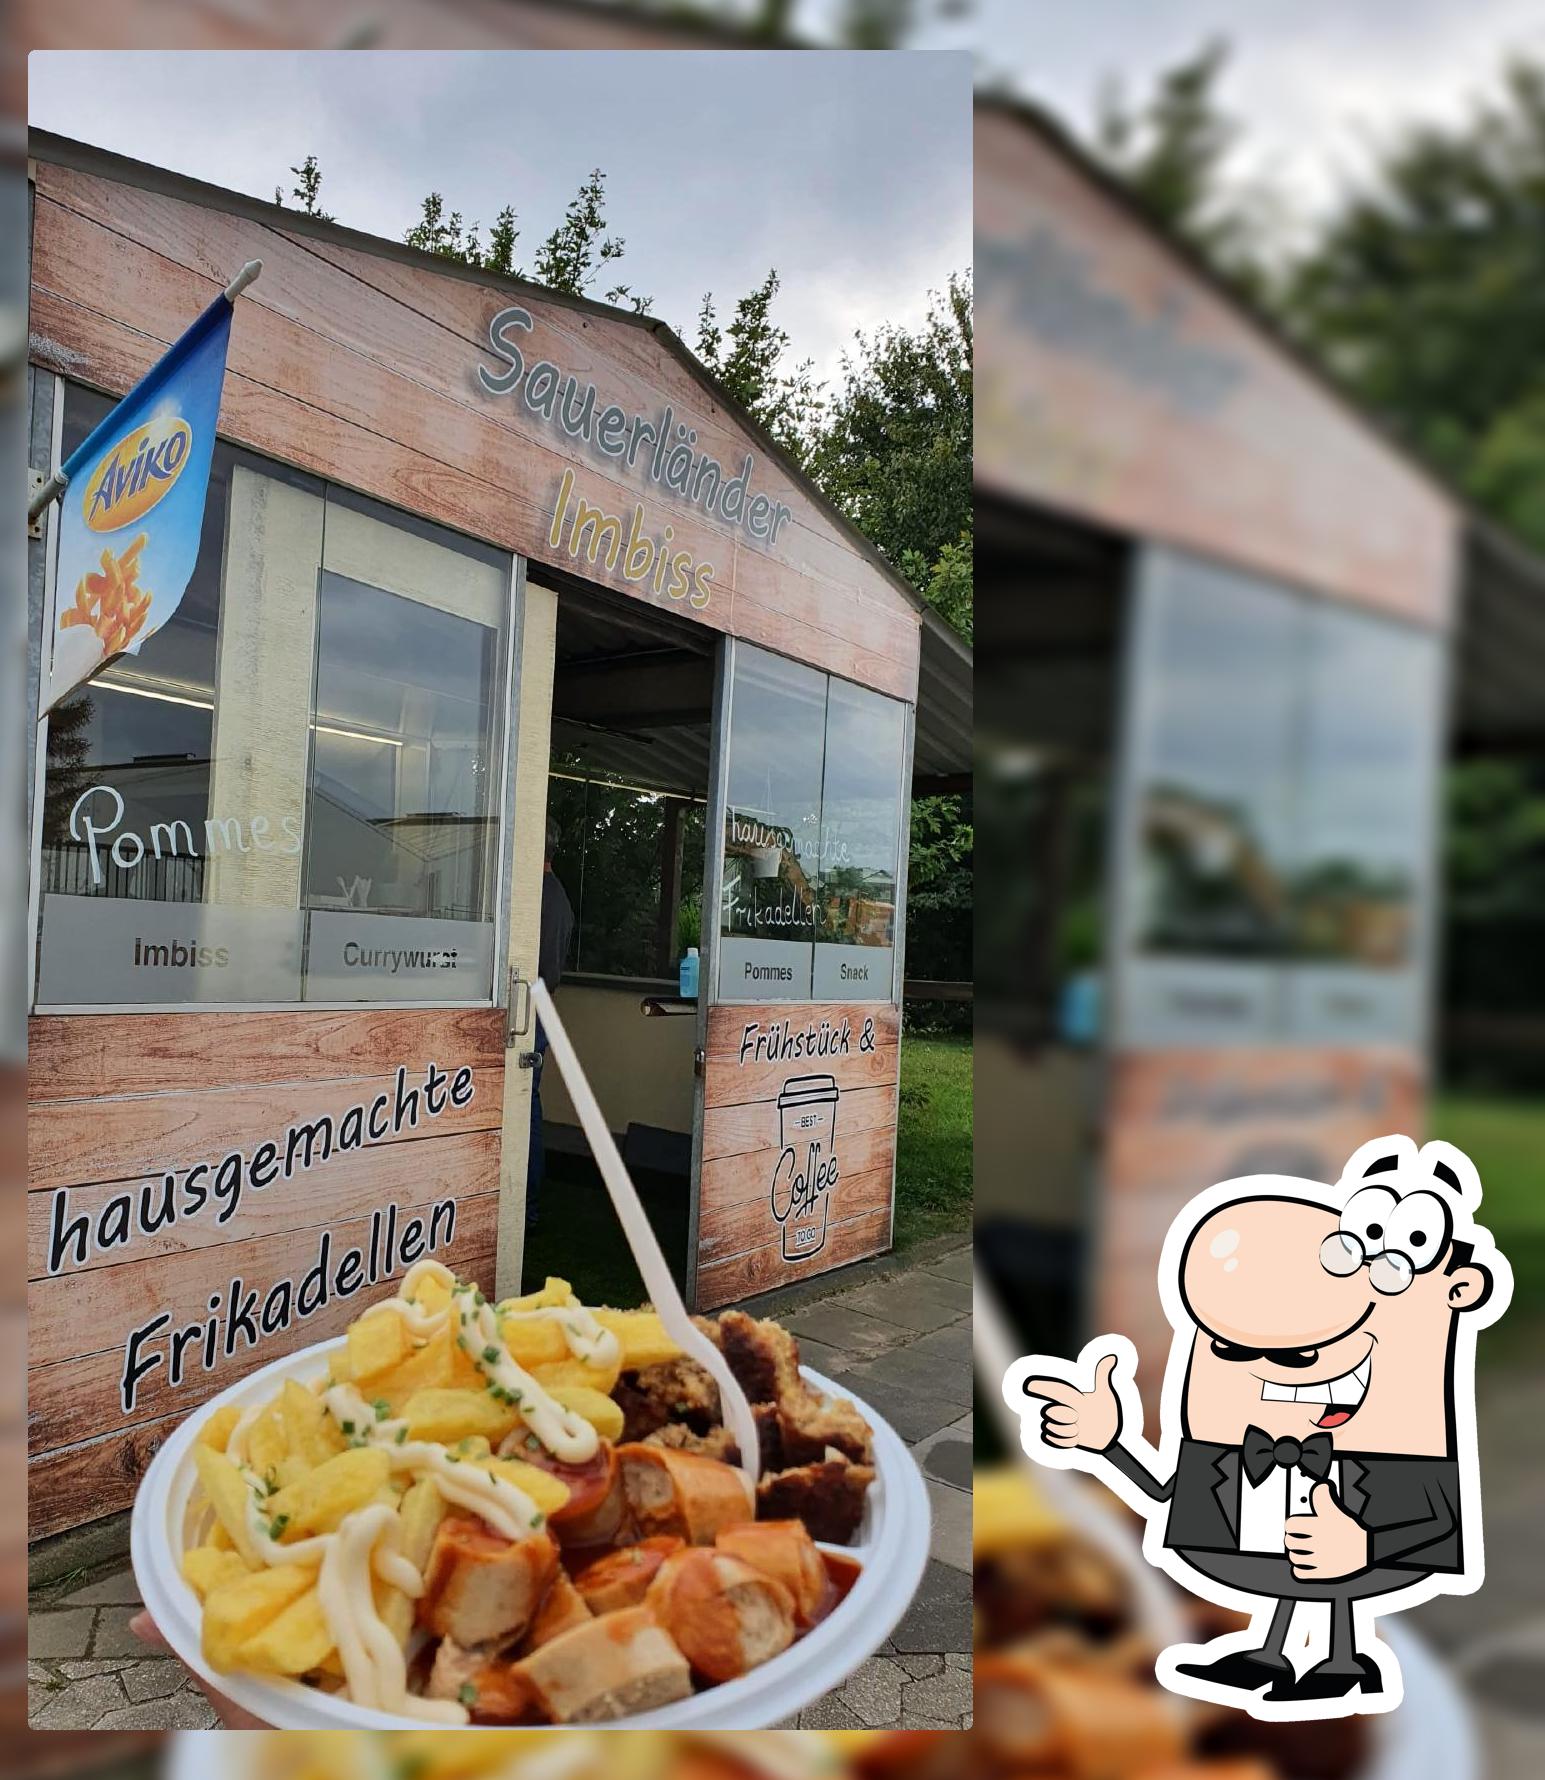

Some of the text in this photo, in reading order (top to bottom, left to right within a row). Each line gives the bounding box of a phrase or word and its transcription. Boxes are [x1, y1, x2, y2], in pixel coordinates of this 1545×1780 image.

[478, 306, 792, 546] Sauerländer
[549, 467, 715, 609] Imbiss
[69, 785, 301, 885] Pommes
[722, 874, 827, 933] Frikadellen
[134, 937, 229, 968] Imbiss
[343, 941, 458, 974] Currywurst
[744, 962, 793, 981] Pommes
[840, 963, 869, 981] Snack
[740, 1017, 876, 1066] Frühstück &
[800, 1114, 818, 1128] BEST
[47, 1063, 475, 1277] hausgemachte
[771, 1142, 840, 1222] Coffee
[121, 1198, 458, 1414] Frikadellen
